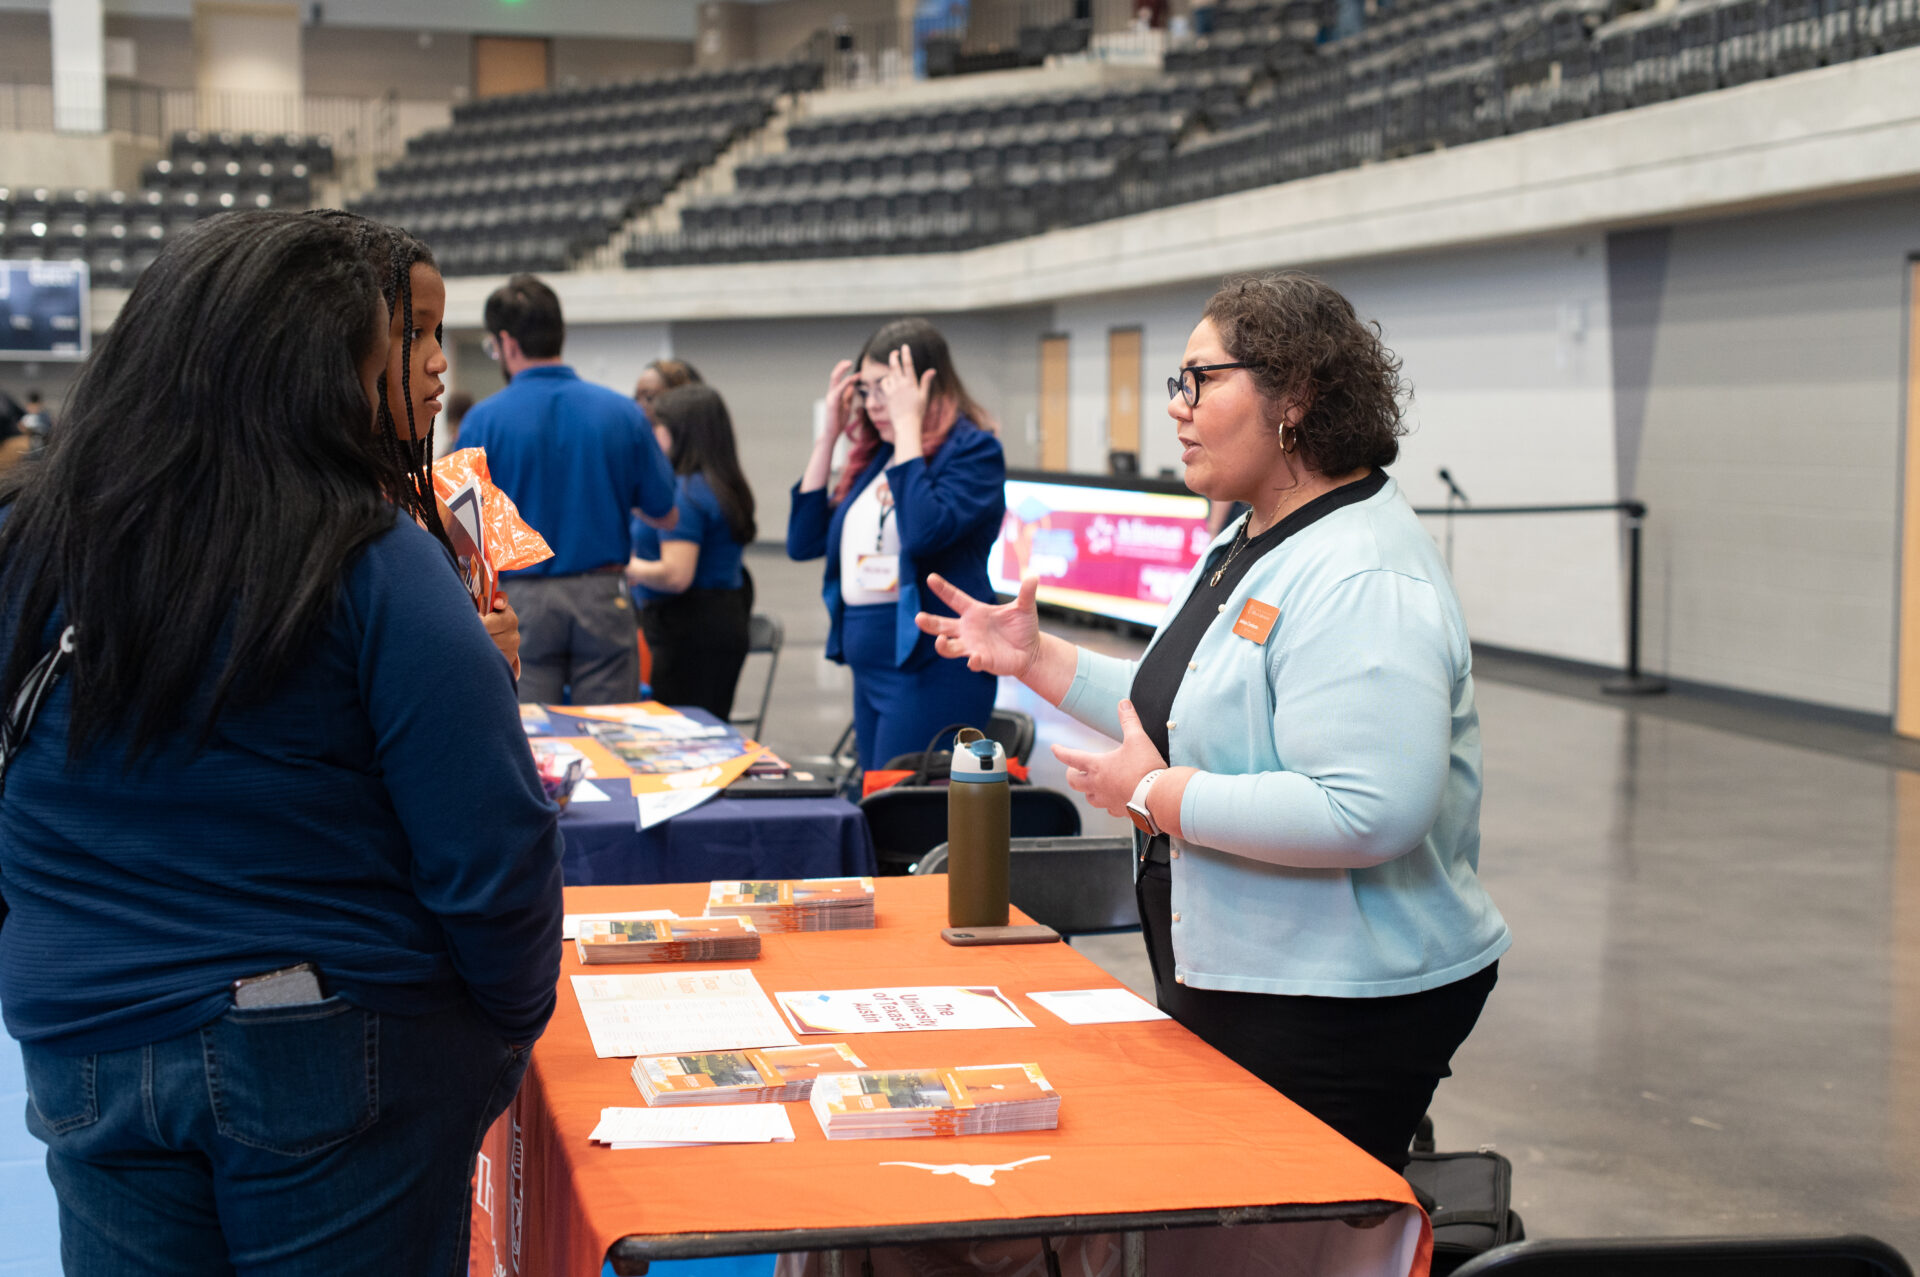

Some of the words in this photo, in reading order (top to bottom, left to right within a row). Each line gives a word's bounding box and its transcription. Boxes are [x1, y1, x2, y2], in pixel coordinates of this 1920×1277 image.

[873, 992, 894, 1001] of
[852, 1002, 881, 1023] Austin
[879, 1001, 905, 1022] Texas
[899, 994, 939, 1026] University
[933, 1003, 955, 1016] The
[895, 1022, 917, 1030] at
